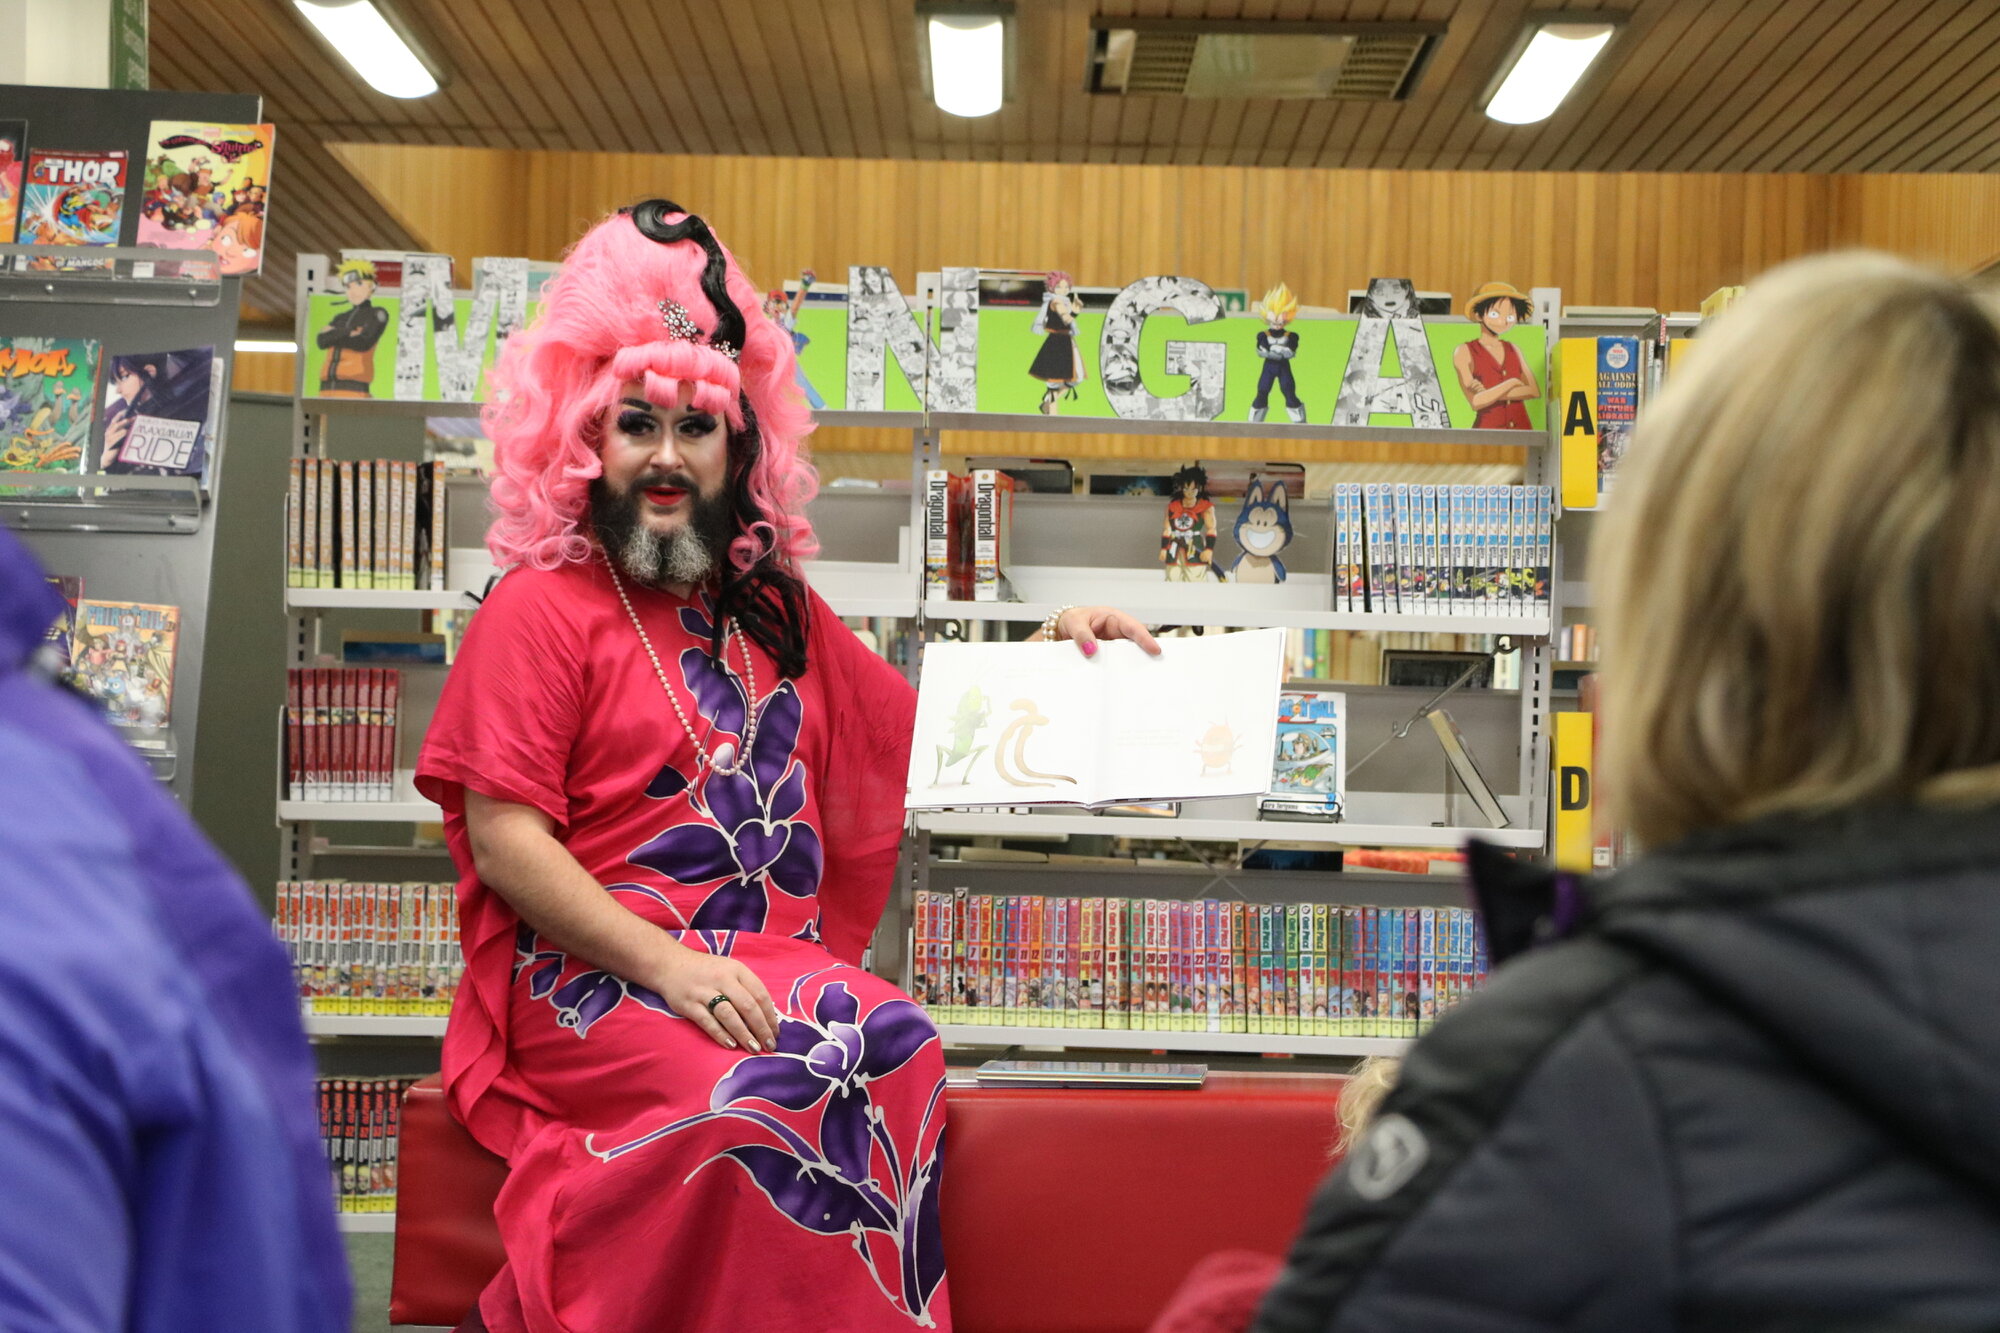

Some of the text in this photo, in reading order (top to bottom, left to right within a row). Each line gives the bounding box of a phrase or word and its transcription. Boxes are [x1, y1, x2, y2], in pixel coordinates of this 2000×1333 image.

[45, 159, 120, 184] THOR
[394, 256, 1452, 428] MNGA
[1599, 372, 1636, 381] AGAINST
[1563, 391, 1595, 436] A
[1597, 412, 1635, 420] LIBRARY
[137, 425, 194, 439] MAXIMUM
[125, 434, 193, 467] RIDE
[306, 771, 315, 783] 8
[1561, 766, 1589, 811] D
[917, 945, 924, 956] 3
[970, 947, 976, 958] 7
[1021, 950, 1028, 959] 11
[1032, 950, 1039, 959] 12
[1094, 950, 1100, 960] 17
[1195, 955, 1204, 965] 22
[1220, 955, 1229, 965] 22
